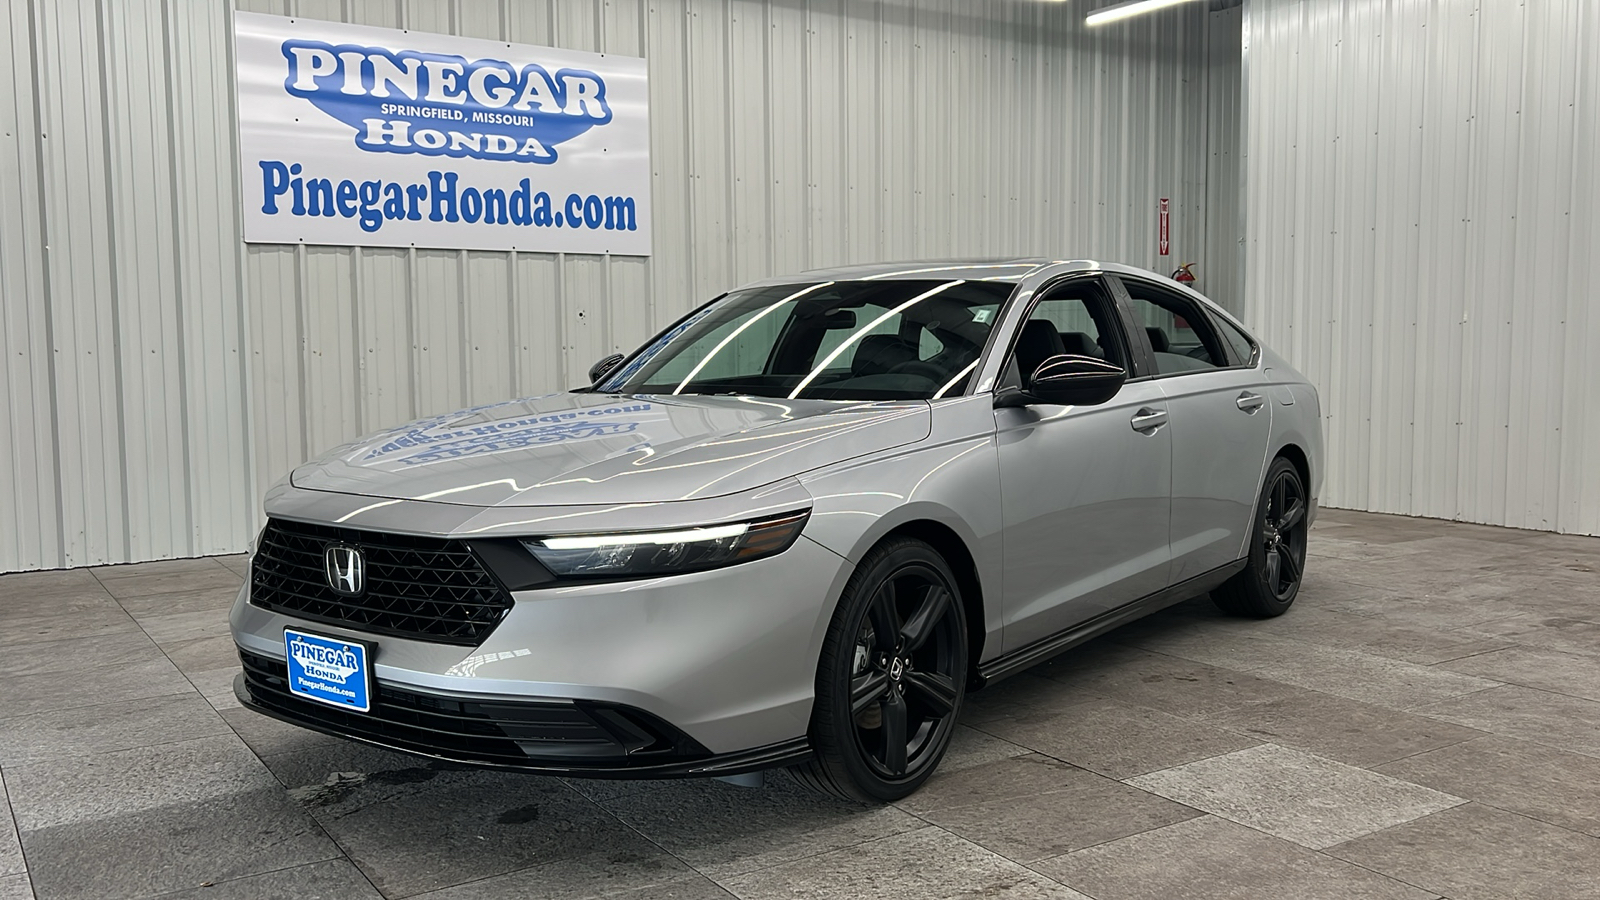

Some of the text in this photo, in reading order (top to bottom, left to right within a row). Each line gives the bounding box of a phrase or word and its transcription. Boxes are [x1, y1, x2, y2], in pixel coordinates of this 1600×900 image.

[290, 46, 607, 120] PINEGAR
[380, 103, 534, 128] SPRINGFIELD, MISSOURI
[362, 118, 552, 158] HONDA
[258, 160, 638, 233] PinegarHonda.com
[292, 643, 357, 670] PINEGAR
[298, 676, 356, 698] PinegarHonda.com
[305, 665, 344, 682] HONDA
